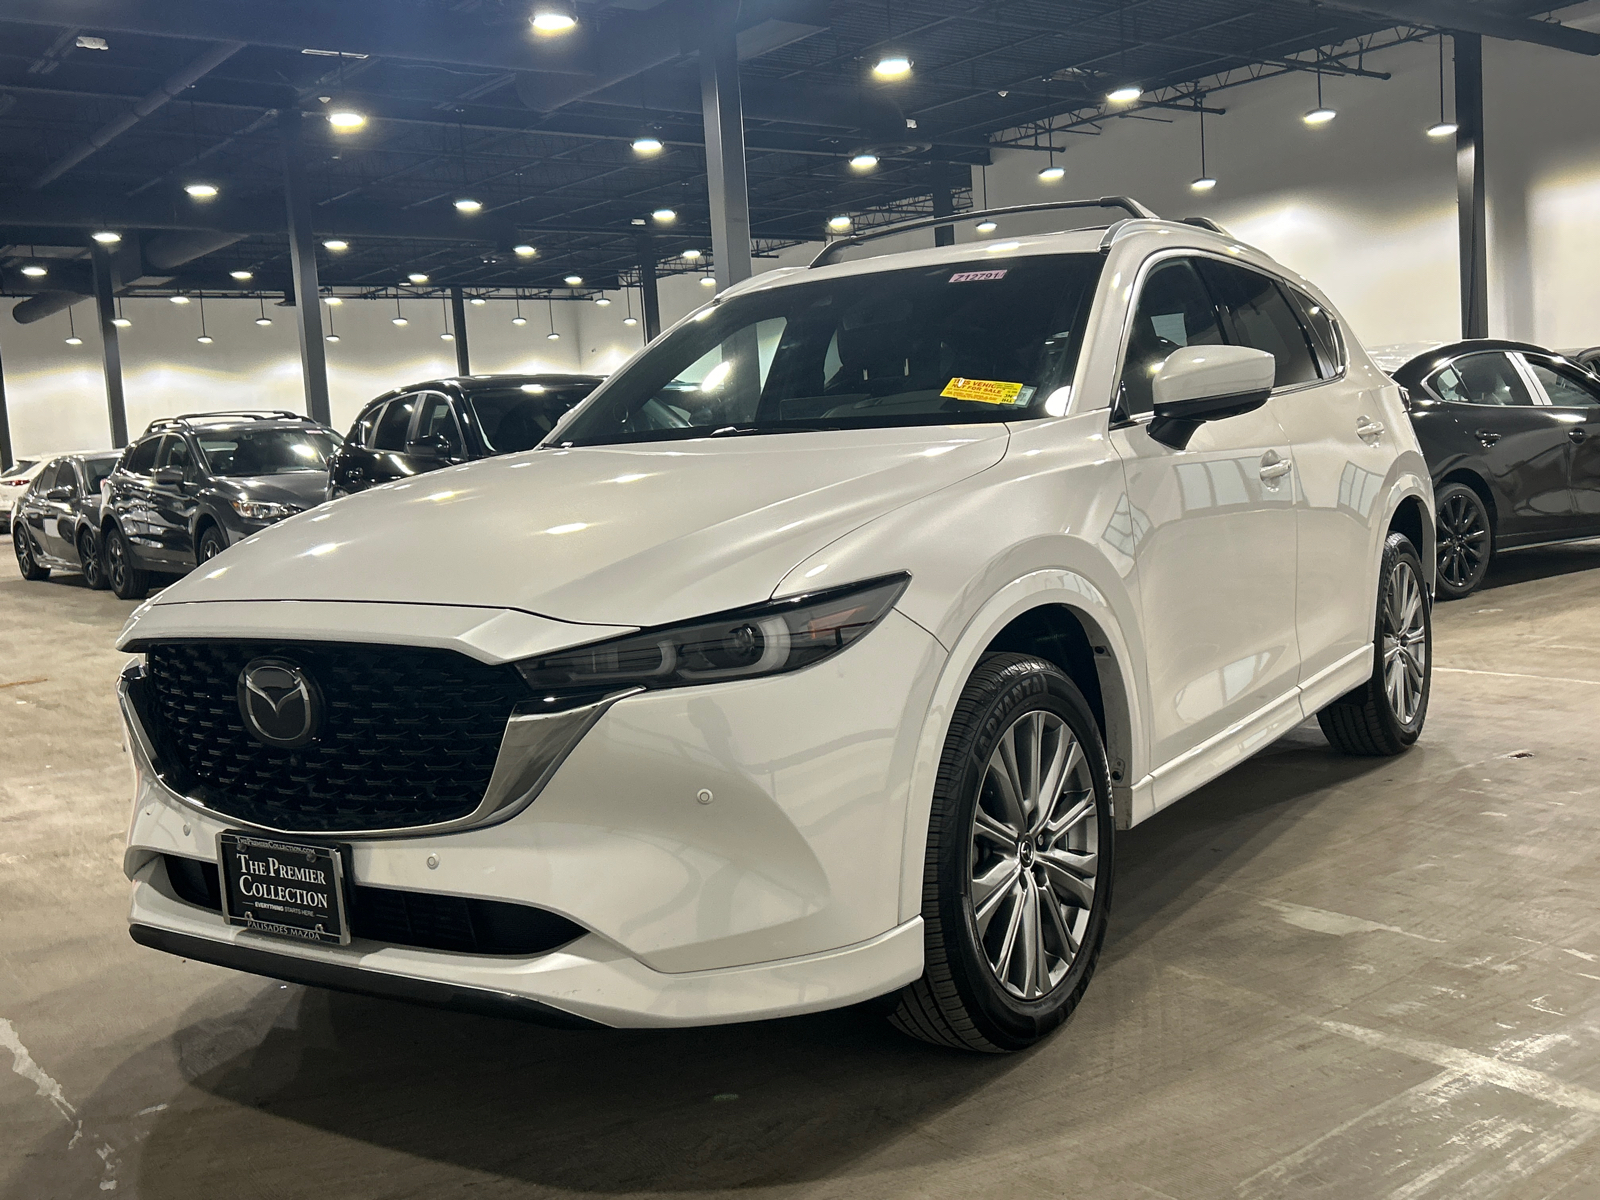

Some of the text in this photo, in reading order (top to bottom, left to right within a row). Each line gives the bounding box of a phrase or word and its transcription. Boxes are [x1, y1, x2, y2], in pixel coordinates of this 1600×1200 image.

[979, 677, 1041, 752] ADVANTA
[236, 853, 327, 885] THE PREMIER
[239, 875, 328, 909] COLLECTION
[255, 901, 284, 912] EVERYTHING
[285, 906, 302, 915] STARTS
[247, 920, 321, 940] PALISADES MAZDA
